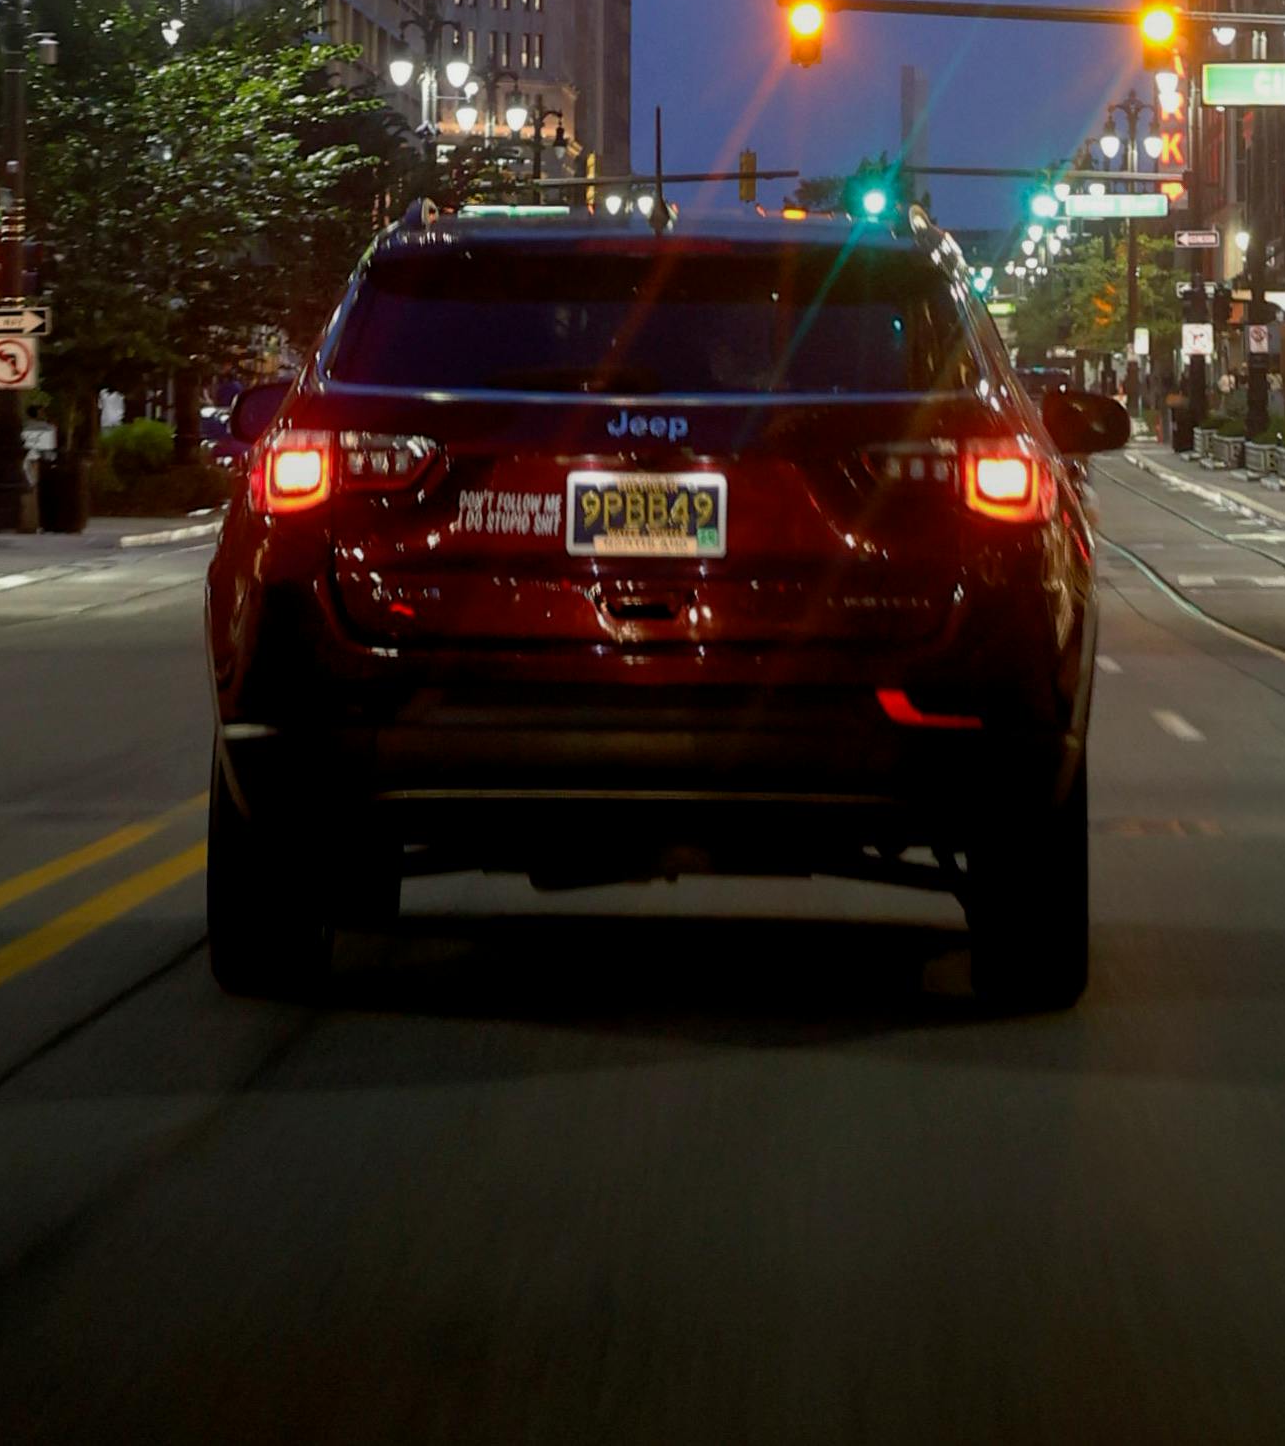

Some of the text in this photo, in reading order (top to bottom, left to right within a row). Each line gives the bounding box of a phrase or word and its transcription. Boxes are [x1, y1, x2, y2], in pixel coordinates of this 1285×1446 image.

[607, 411, 689, 442] Jeep
[458, 489, 562, 513] DON'T FOLLOW ME
[581, 490, 713, 531] 9PBB49
[465, 512, 484, 533] DO
[484, 512, 530, 536] STUPID
[533, 513, 562, 536] SHIT
